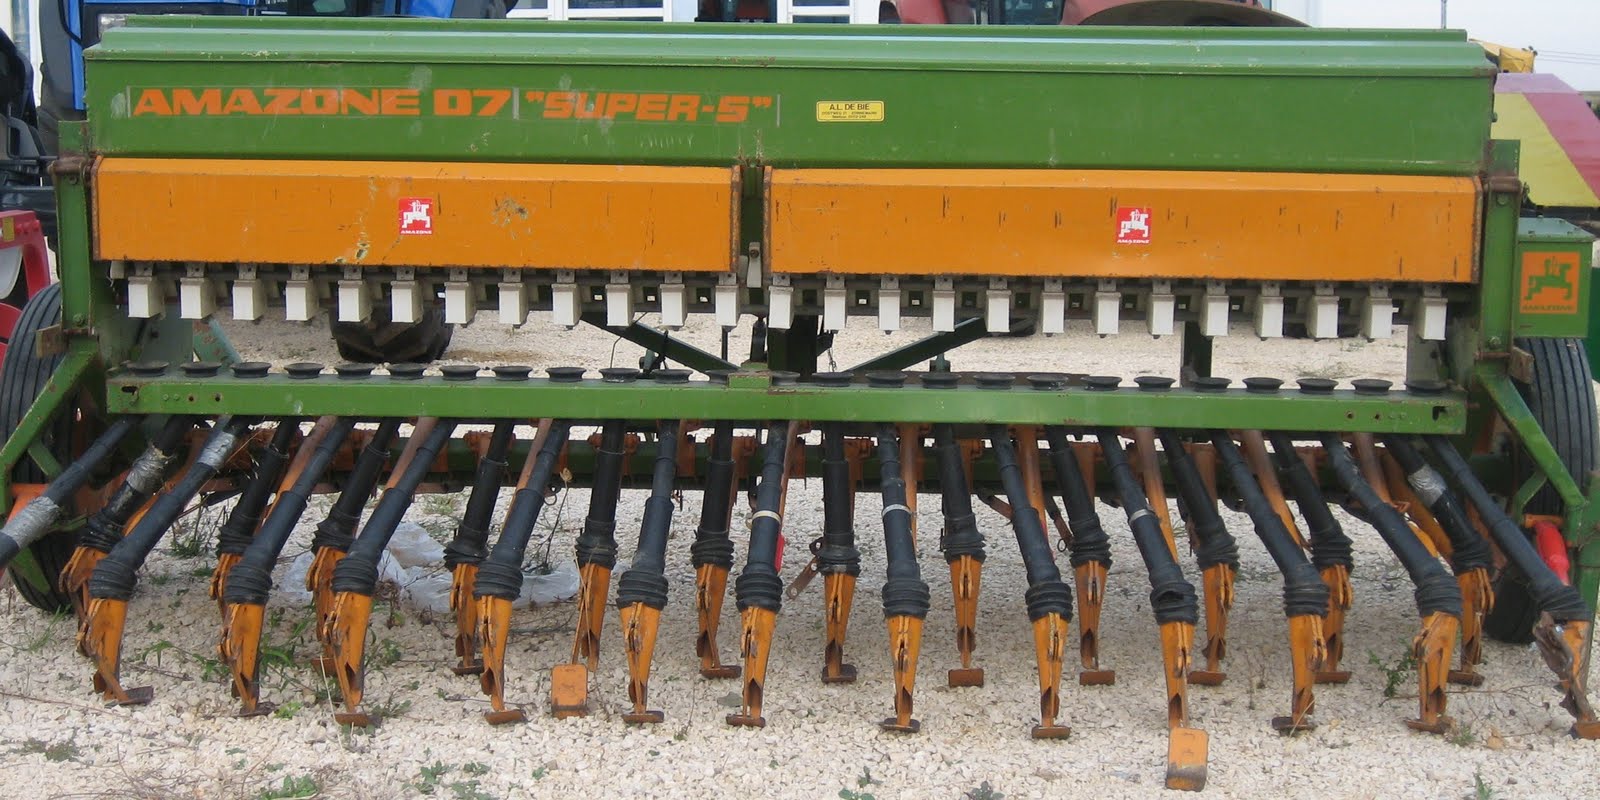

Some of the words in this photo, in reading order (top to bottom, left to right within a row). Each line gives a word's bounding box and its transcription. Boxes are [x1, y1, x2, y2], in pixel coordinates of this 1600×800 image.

[132, 88, 421, 116] AMAZONE
[844, 103, 855, 111] DE
[857, 103, 870, 111] BIE
